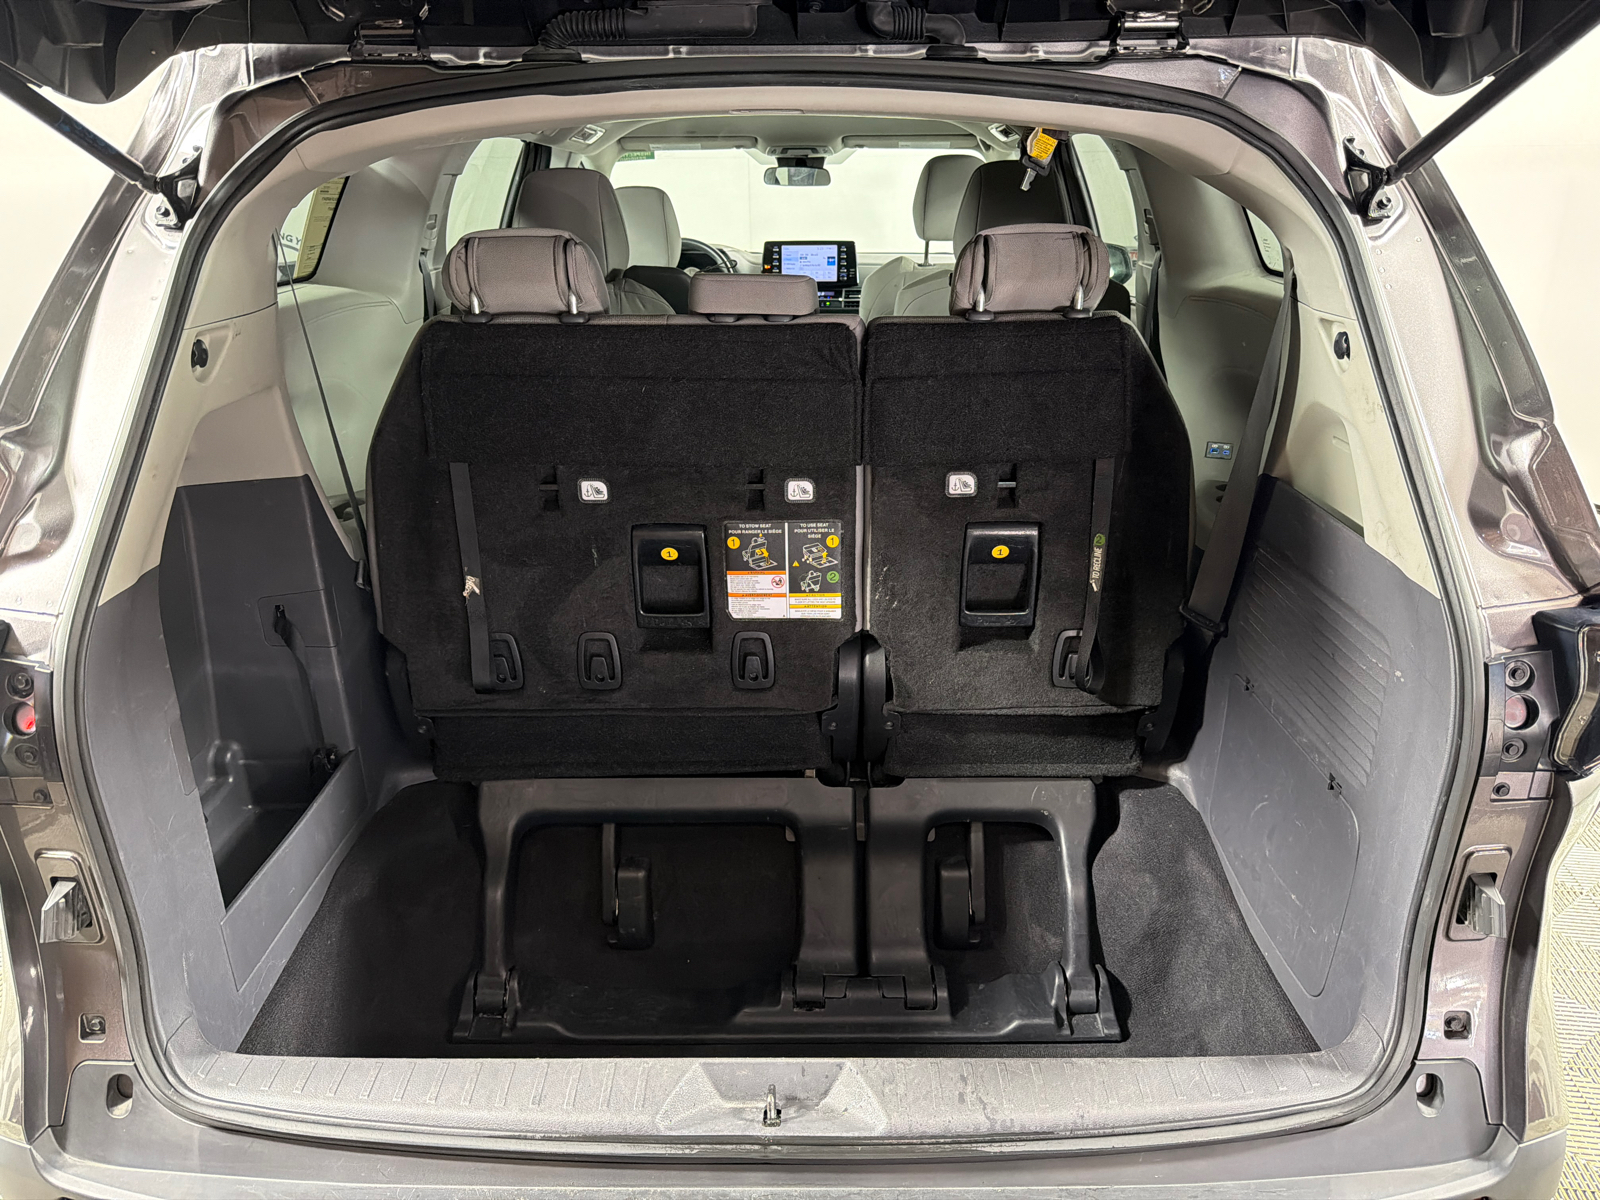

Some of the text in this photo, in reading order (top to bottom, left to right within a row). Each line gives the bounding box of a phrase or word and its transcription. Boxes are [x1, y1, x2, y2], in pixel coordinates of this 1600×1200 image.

[1096, 534, 1102, 544] 2
[1093, 546, 1102, 571] RECLINE
[829, 573, 837, 581] 2
